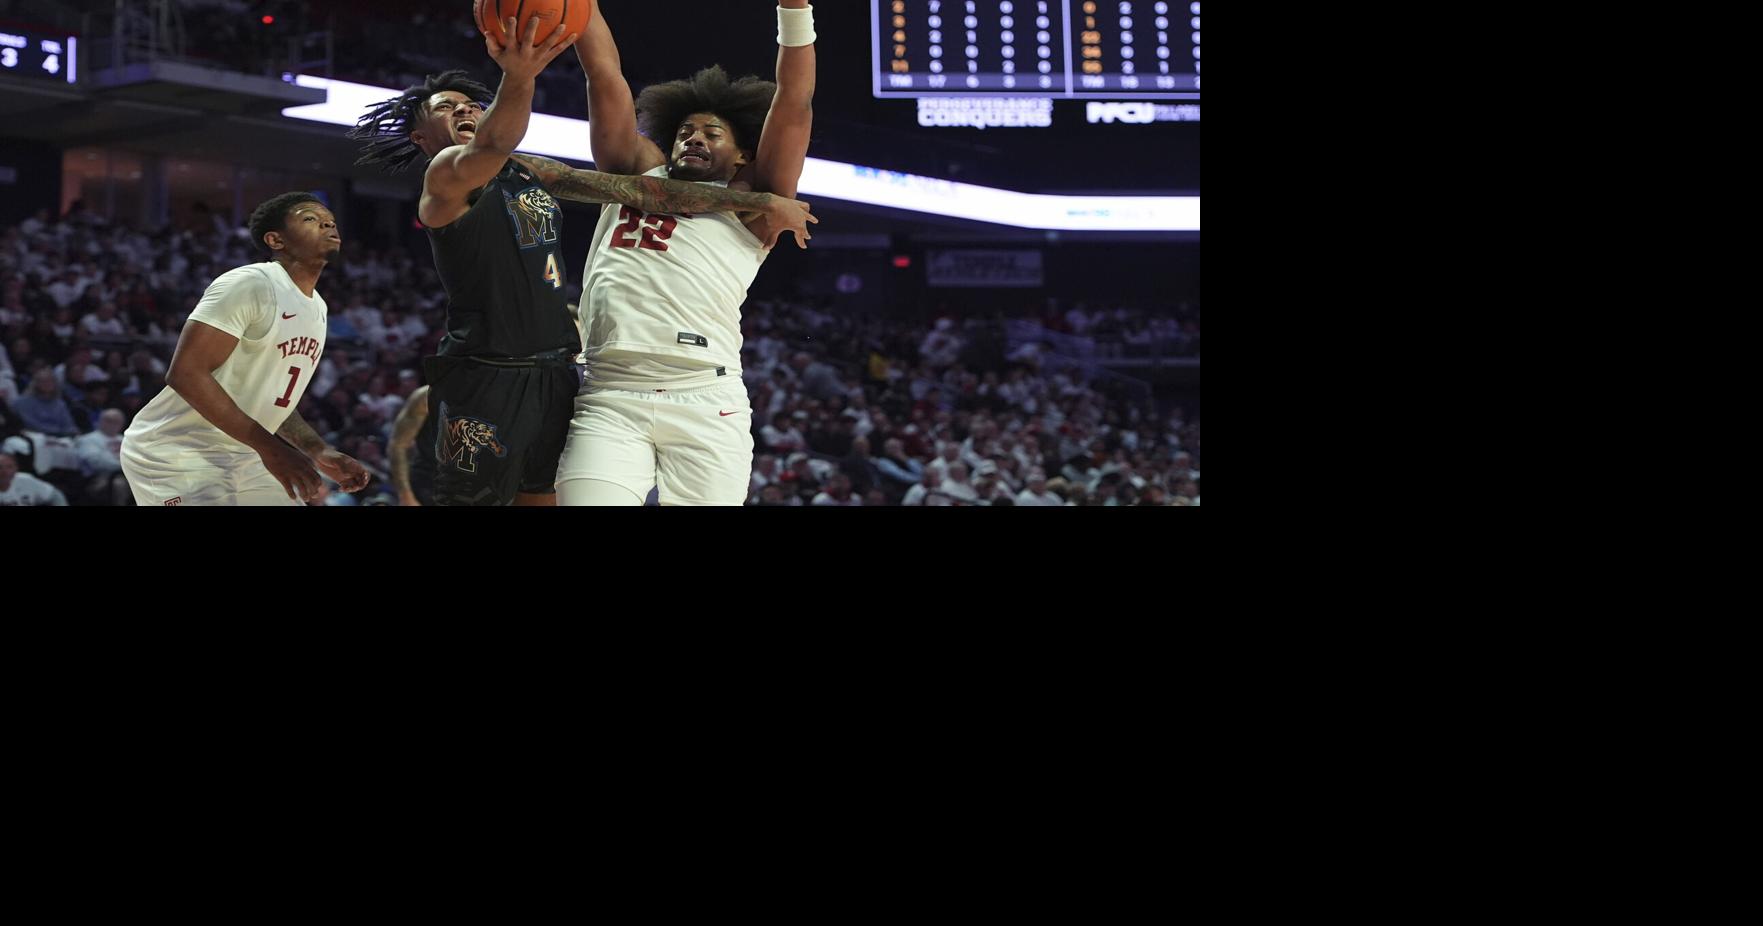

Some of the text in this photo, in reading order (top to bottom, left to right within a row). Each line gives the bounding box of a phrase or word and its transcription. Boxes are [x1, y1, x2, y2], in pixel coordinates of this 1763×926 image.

[1, 47, 60, 74] 3 4
[506, 199, 558, 248] M
[609, 204, 678, 252] 22
[544, 252, 561, 288] 4
[277, 336, 322, 367] TEMPL
[274, 365, 302, 408] 1
